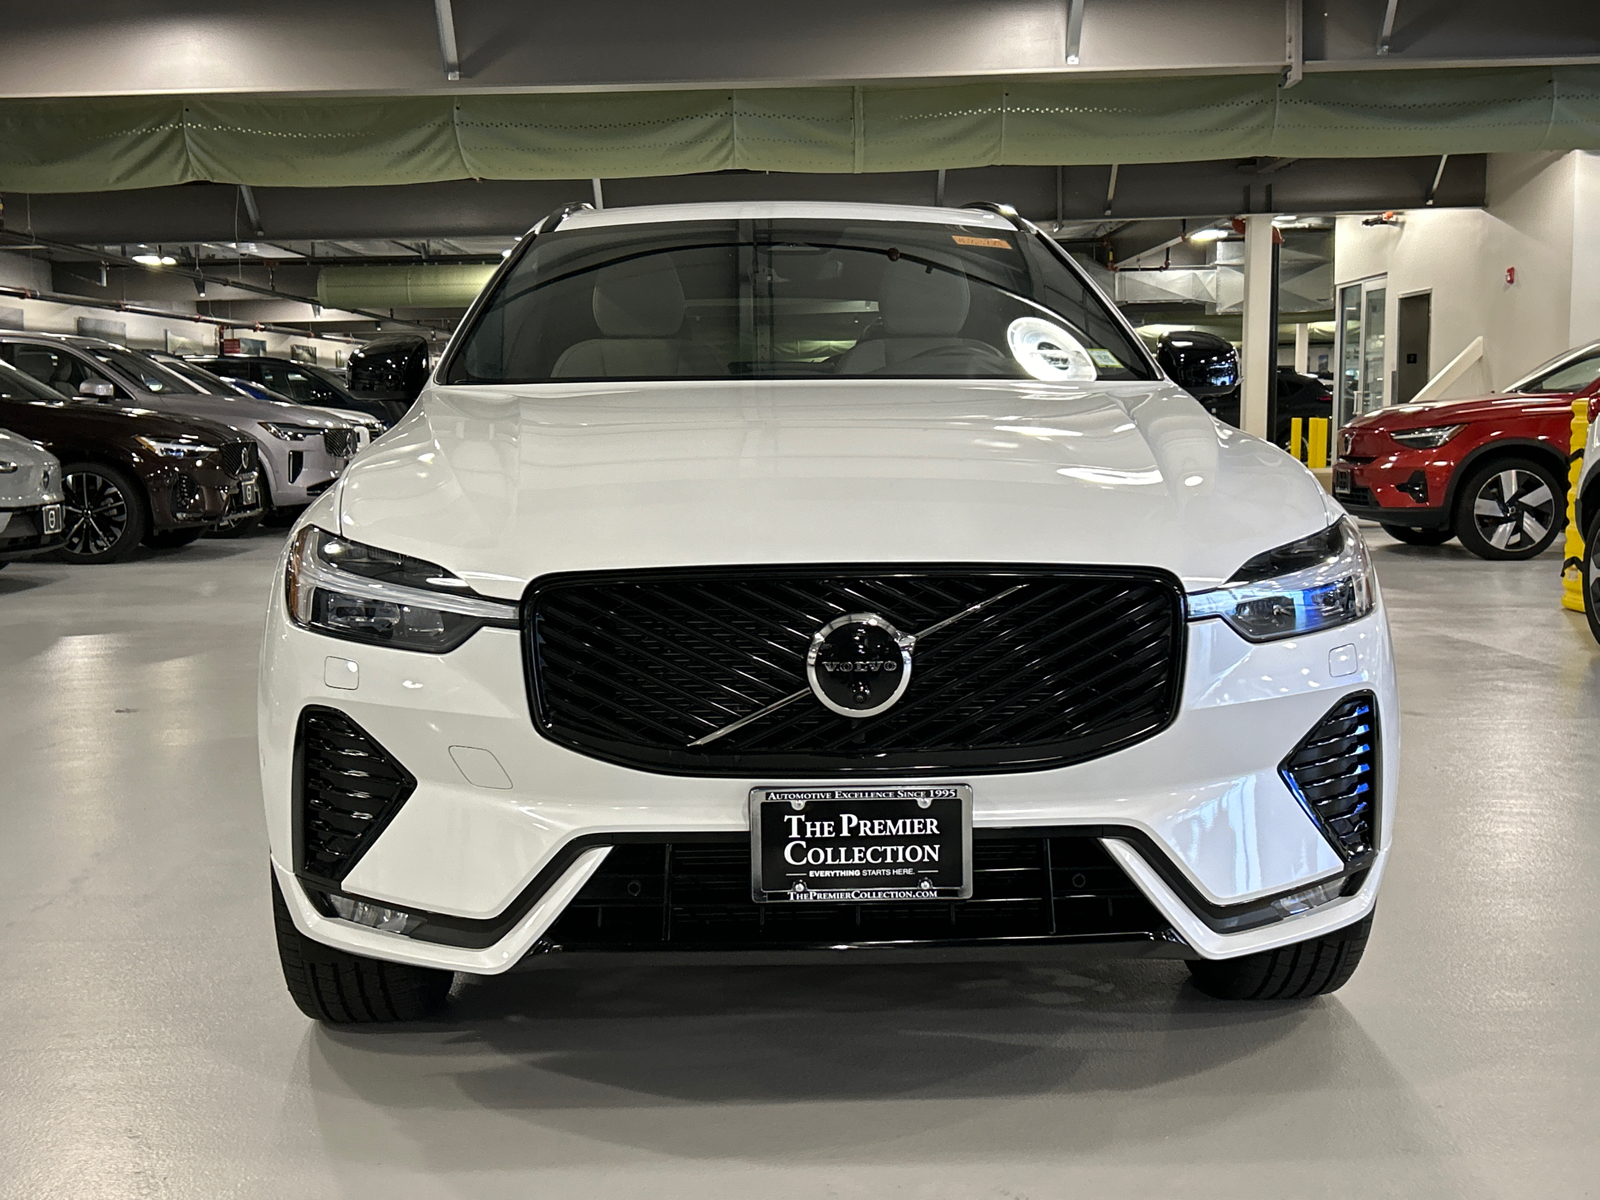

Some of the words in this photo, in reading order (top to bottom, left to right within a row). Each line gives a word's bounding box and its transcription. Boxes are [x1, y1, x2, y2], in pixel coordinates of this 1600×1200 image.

[822, 660, 897, 672] VOLVO
[768, 791, 832, 800] AUTOMOTIVE
[834, 790, 895, 799] EXCELLENCE
[897, 789, 926, 798] SINCE
[929, 788, 956, 798] 1995
[783, 814, 836, 838] THE
[839, 813, 940, 837] PREMIER
[783, 840, 941, 865] COLLECTION
[862, 868, 892, 876] STARTS
